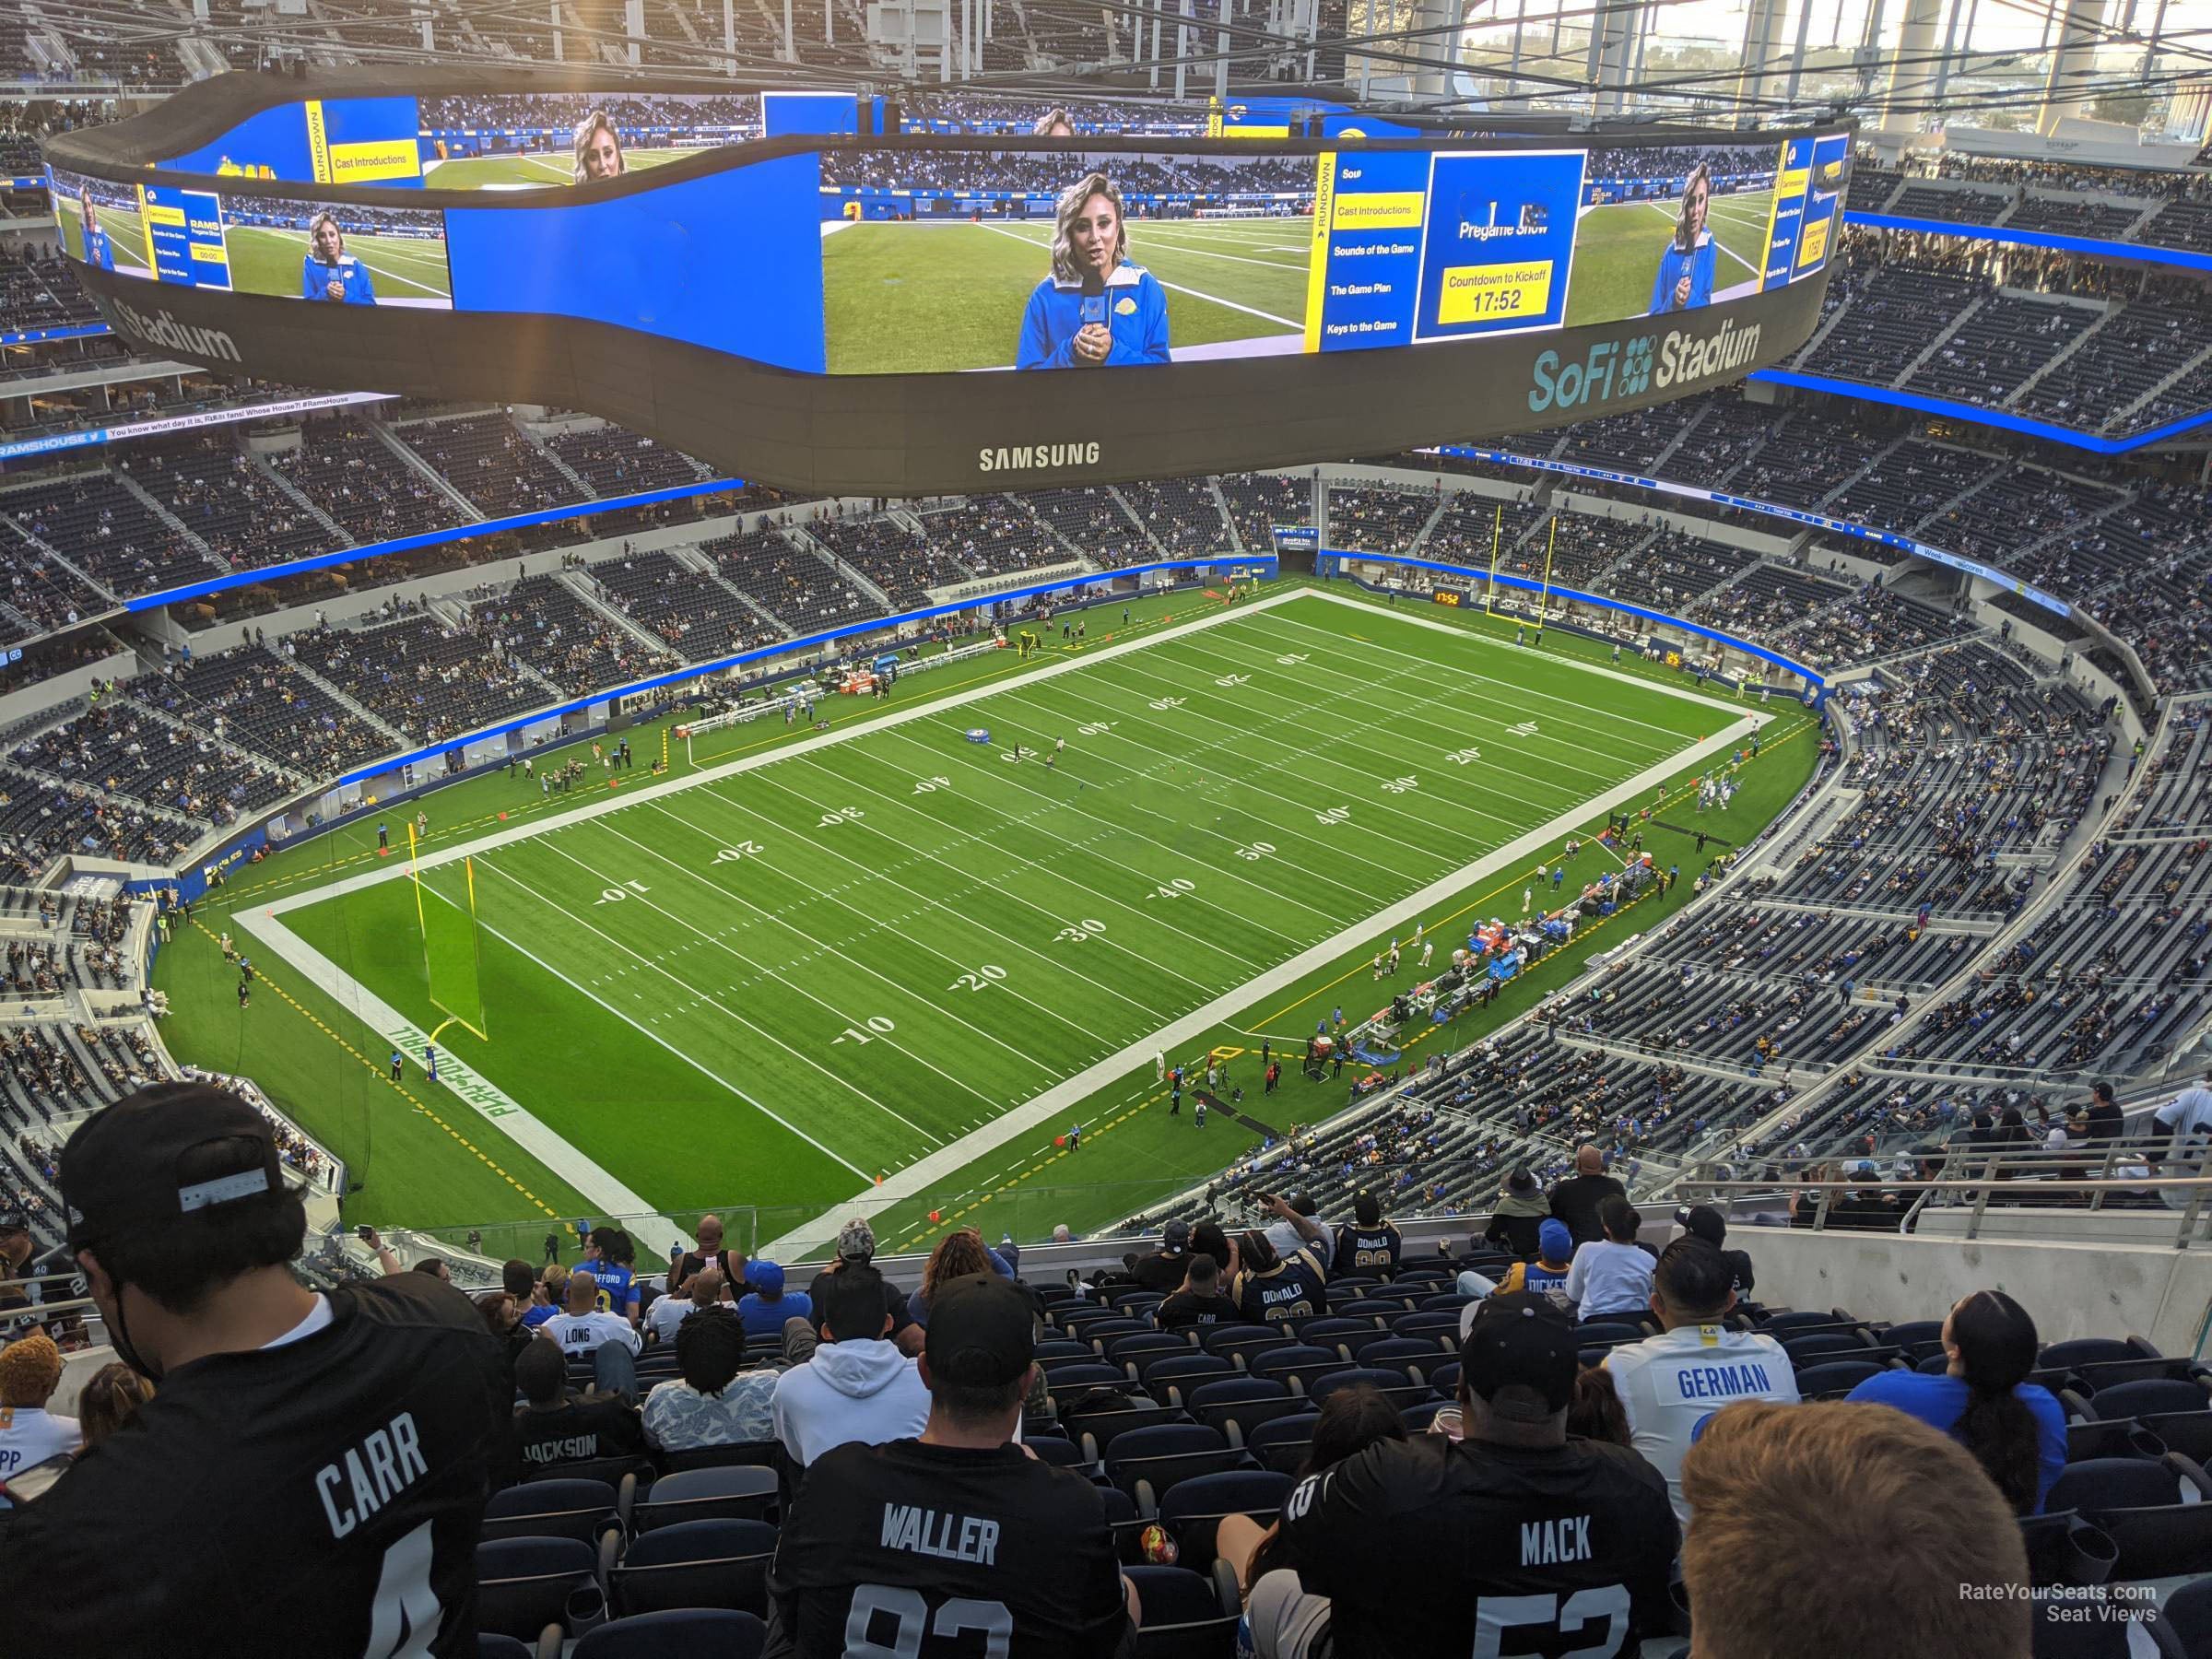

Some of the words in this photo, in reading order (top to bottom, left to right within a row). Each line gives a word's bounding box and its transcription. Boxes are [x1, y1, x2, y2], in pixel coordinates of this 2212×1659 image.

[312, 112, 326, 182] RUNDOWN
[335, 159, 353, 170] Cast
[355, 155, 406, 167] Introductions
[1318, 162, 1331, 227] RUNDOWN
[1338, 206, 1357, 216] Cast
[1359, 205, 1412, 216] Introductions
[190, 219, 220, 230] RAMS
[1335, 246, 1365, 256] Sounds
[1366, 245, 1375, 254] of
[1377, 245, 1390, 254] the
[1392, 244, 1414, 254] Game
[1449, 274, 1502, 288] Countdown
[1504, 274, 1513, 284] to
[1515, 269, 1547, 282] Kickoff
[1331, 286, 1347, 295] The
[1347, 285, 1371, 295] Game
[1372, 284, 1392, 293] Plan
[1474, 289, 1522, 313] 17:52
[112, 297, 241, 362] Stadium
[1327, 324, 1347, 334] Keys
[1349, 323, 1358, 332] to
[1359, 323, 1371, 332] the
[1373, 321, 1397, 330] Game
[1528, 341, 1620, 412] SoFi
[1655, 317, 1760, 388] Stadium
[111, 428, 125, 437] You
[128, 425, 149, 433] know
[151, 422, 171, 430] what
[172, 418, 186, 429] day
[246, 407, 271, 417] Whose
[979, 442, 1099, 471] SAMSUNG
[1924, 547, 1943, 560] Week
[1436, 592, 1459, 605] 17:52
[1215, 673, 1248, 688] 20
[1148, 697, 1184, 712] 30
[1078, 721, 1110, 736] 40
[1506, 723, 1539, 737] 10
[1445, 747, 1481, 765] 20
[915, 775, 952, 793] 40
[1381, 776, 1419, 794] 30
[822, 806, 865, 826] 30
[1314, 807, 1351, 827] 40
[717, 840, 765, 862] 20
[1235, 842, 1277, 862] 50
[602, 879, 652, 902] 10
[1157, 878, 1196, 900] 40
[1060, 919, 1108, 943] 30
[957, 964, 1007, 992] 20
[842, 1016, 896, 1046] 10
[388, 1026, 474, 1083] FOOBALL
[1357, 1236, 1388, 1248] DONALD
[591, 1273, 620, 1283] AFFORD
[1263, 1283, 1303, 1304] DONALD
[1198, 1313, 1217, 1325] CARR
[565, 1327, 590, 1344] LONG
[1677, 1364, 1771, 1399] GERMAN
[523, 1434, 597, 1464] JACKSON
[315, 1411, 429, 1540] CARR
[881, 1502, 1001, 1567] WALLER
[1521, 1515, 1592, 1567] MACK
